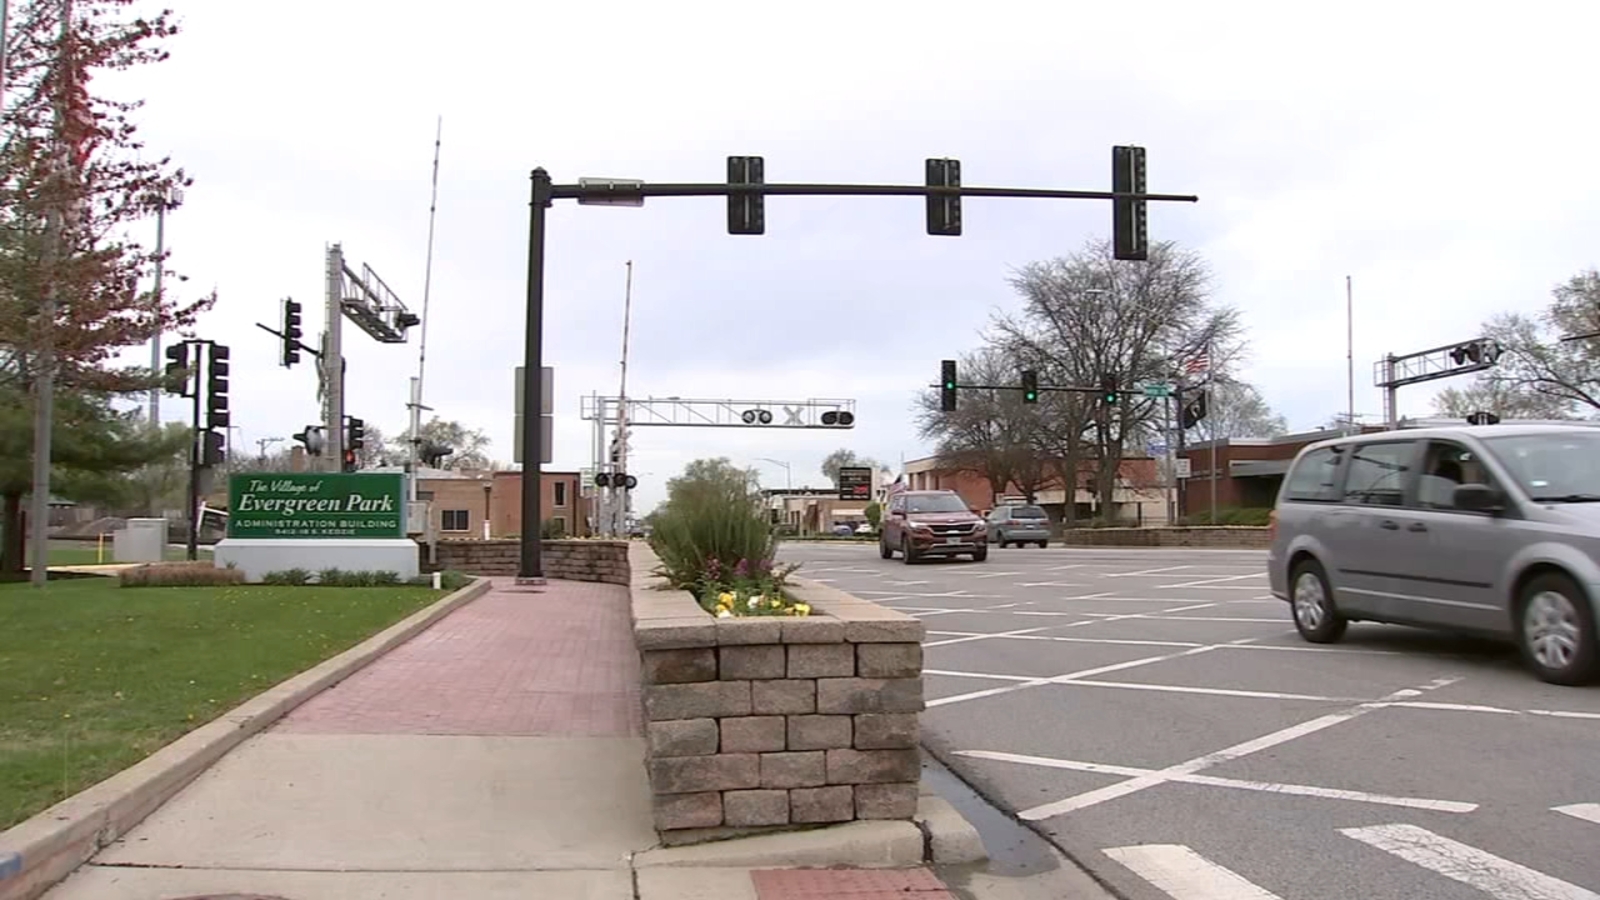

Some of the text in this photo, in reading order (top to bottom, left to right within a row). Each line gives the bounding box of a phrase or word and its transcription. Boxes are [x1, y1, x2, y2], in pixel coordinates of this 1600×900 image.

[250, 479, 324, 496] The Village of
[238, 493, 394, 516] Evergreen Park
[235, 520, 397, 528] ADMINISTRATION BUILDING
